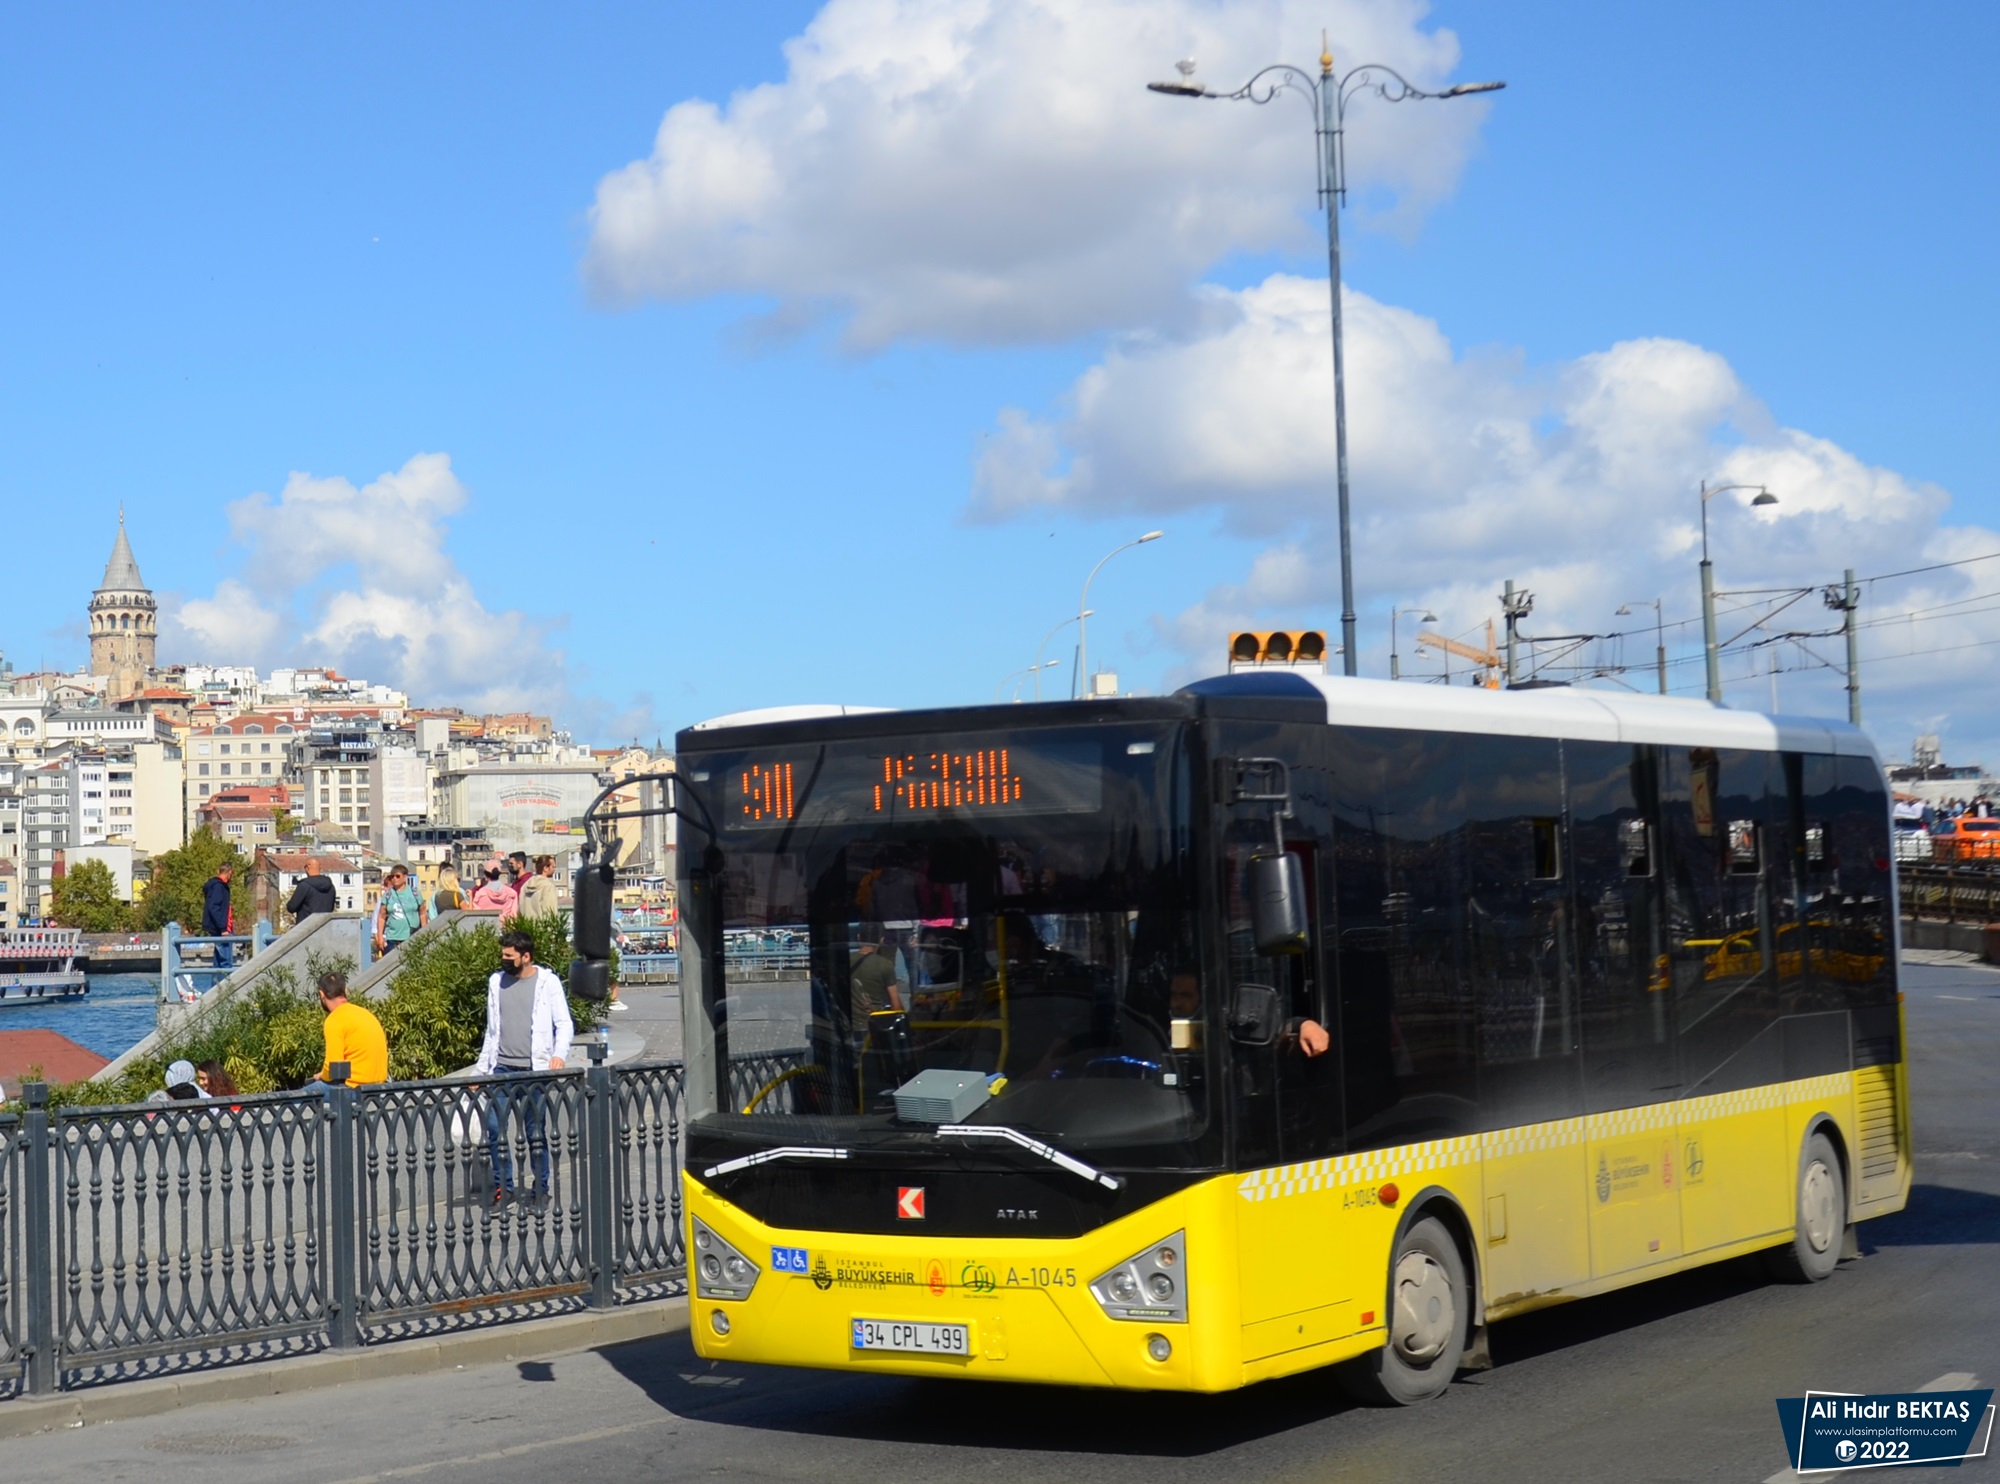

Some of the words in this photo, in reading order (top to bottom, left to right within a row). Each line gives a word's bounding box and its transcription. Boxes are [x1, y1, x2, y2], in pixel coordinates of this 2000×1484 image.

[996, 1209, 1039, 1219] ATAK
[836, 1259, 885, 1268] İSTANBUL
[837, 1265, 915, 1284] BÜYÜKŞEHİR
[1006, 1267, 1077, 1287] A-1045
[865, 1323, 885, 1345] 34
[893, 1325, 923, 1347] CPL
[931, 1327, 962, 1350] 499
